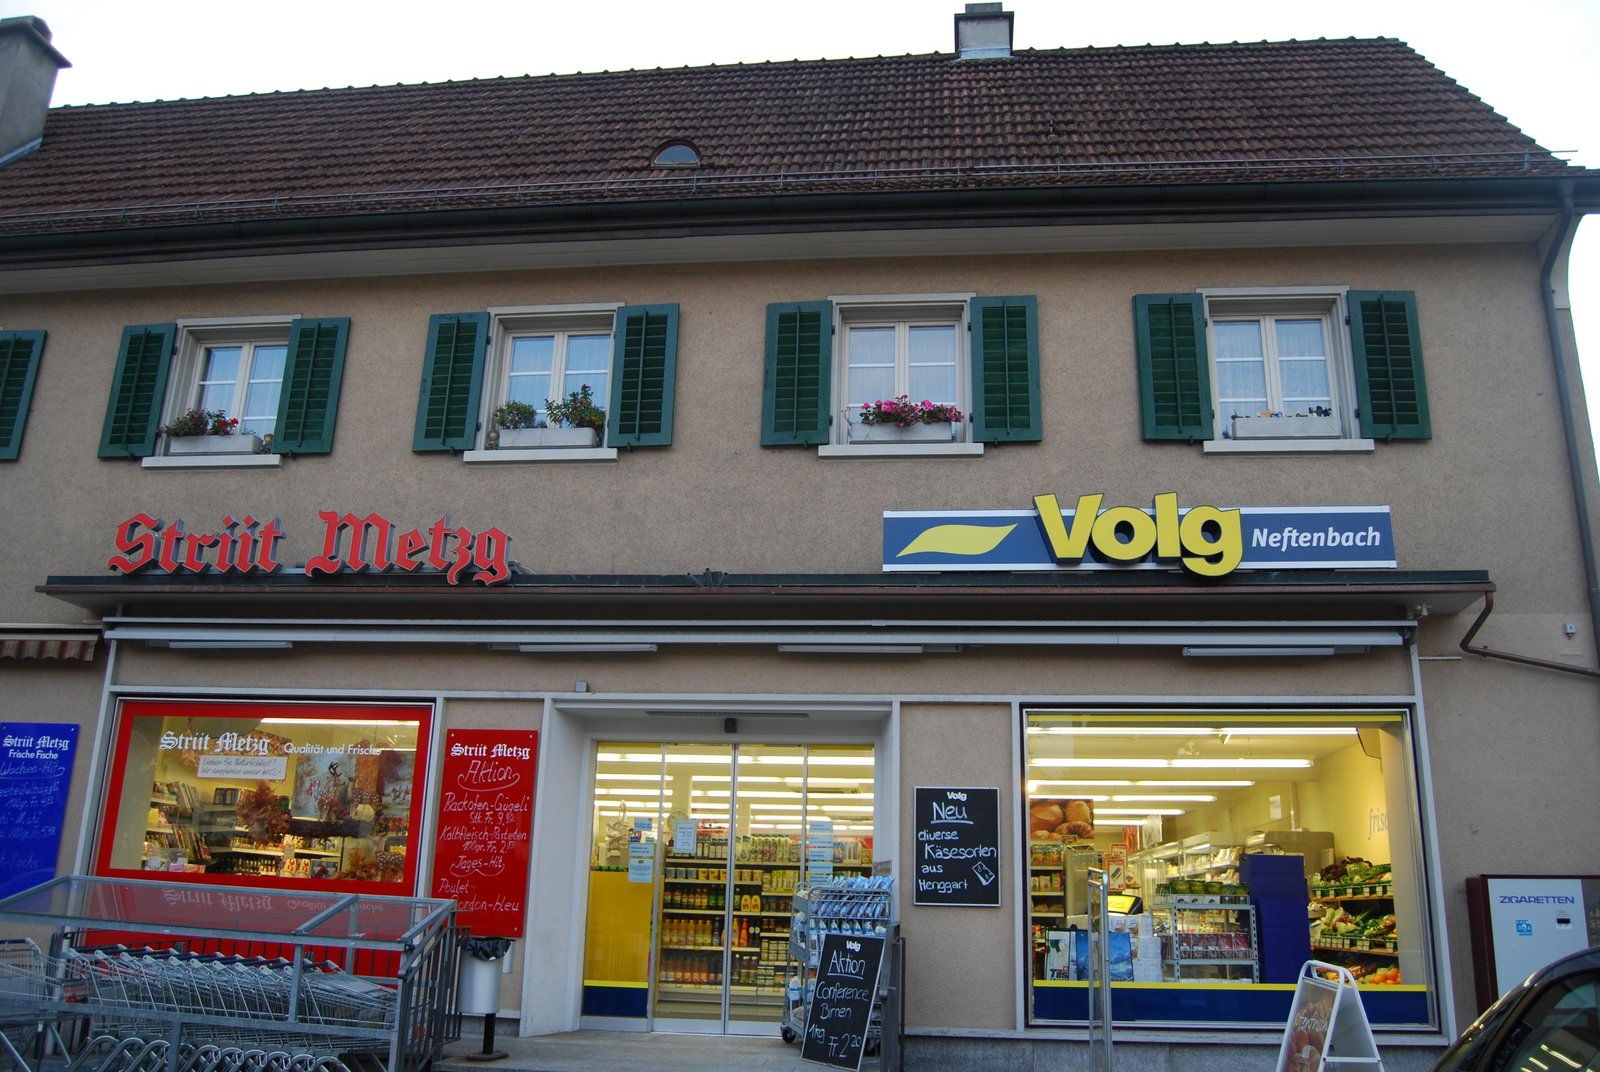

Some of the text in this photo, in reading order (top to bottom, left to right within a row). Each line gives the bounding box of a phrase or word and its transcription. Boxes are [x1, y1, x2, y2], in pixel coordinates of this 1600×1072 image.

[1032, 491, 1382, 578] Volg Neftenbach
[304, 510, 515, 587] Metzg
[36, 736, 70, 750] Metzg
[214, 732, 270, 756] Metzg
[284, 742, 382, 756] Qualität und Frische
[9, 749, 59, 759] Frische Fische
[490, 743, 531, 760] Metzg
[464, 759, 512, 784] Aktion
[947, 791, 968, 802] Volg
[932, 801, 968, 821] Neu
[918, 829, 959, 841] diverse
[924, 843, 997, 860] Käsesorten
[921, 864, 943, 874] aus
[918, 879, 968, 893] Henggart
[1499, 895, 1575, 904] ZIGARETTEN
[846, 940, 861, 952] Volg
[828, 949, 866, 976] Aktion
[816, 981, 869, 1003] Conference
